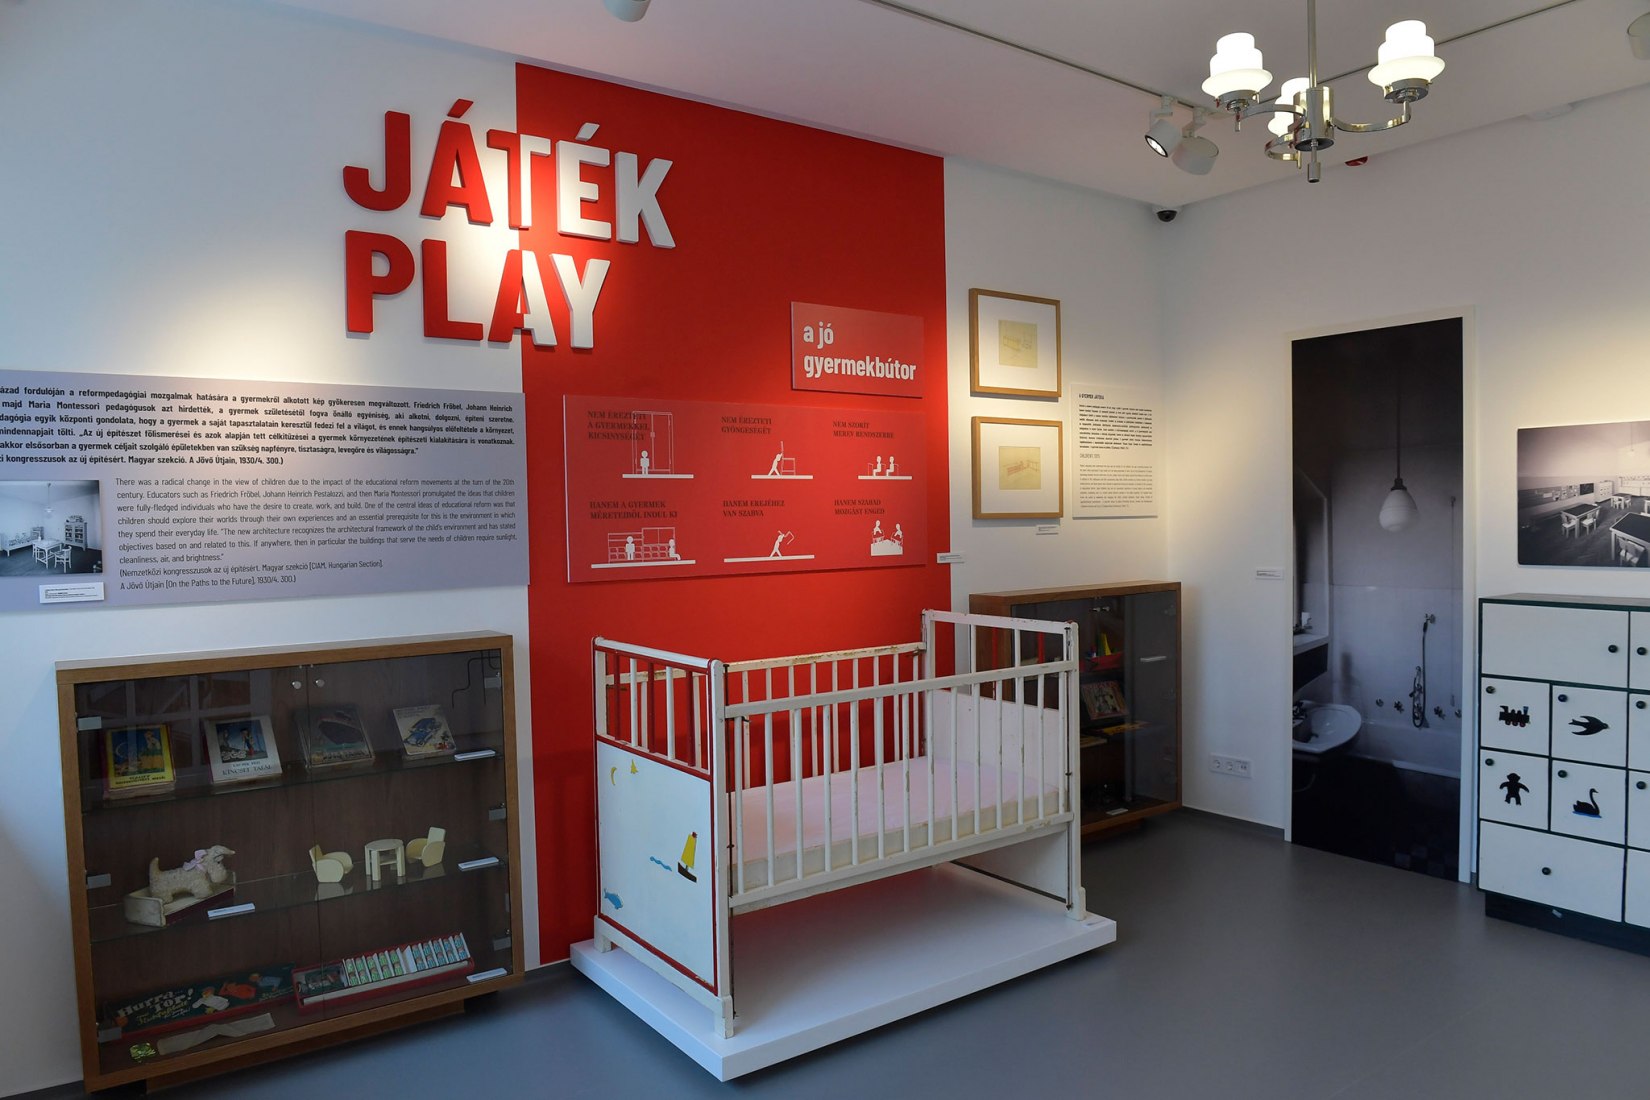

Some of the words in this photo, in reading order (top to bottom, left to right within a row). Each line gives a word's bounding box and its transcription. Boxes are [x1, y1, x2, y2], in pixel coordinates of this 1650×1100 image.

[343, 98, 676, 248] JÁTÉK
[345, 230, 610, 349] PLAY
[804, 326, 814, 342] a
[818, 322, 834, 349] jó
[804, 355, 916, 380] gyermekbútor
[24, 387, 65, 397] fordulóján
[79, 388, 146, 400] reformpedagógiai
[150, 391, 192, 401] mozgalmak
[240, 394, 280, 405] gyermekről
[283, 395, 309, 404] alkotott
[312, 396, 325, 406] kép
[328, 397, 365, 408] gyökeresen
[414, 400, 440, 408] Friedrich
[2, 400, 22, 409] majd
[106, 402, 156, 413] pedagógusok
[228, 406, 259, 416] gyermek
[310, 409, 328, 418] fogva
[357, 410, 390, 420] egyéniség,
[35, 415, 56, 423] egyik
[60, 415, 93, 424] központi
[96, 415, 136, 425] gondolata,
[138, 417, 157, 426] hogy
[167, 417, 199, 426] gyermek
[209, 418, 226, 427] saját
[229, 418, 278, 429] tapasztalatain
[281, 419, 312, 428] keresztül
[314, 420, 334, 429] fedezi
[336, 421, 345, 429] fel
[354, 421, 376, 431] világot,
[389, 422, 407, 430] ennek
[96, 429, 103, 438] új
[107, 429, 141, 439] építészet
[225, 432, 250, 440] alapján
[318, 433, 346, 442] gyermek
[350, 434, 395, 444] környezetének
[26, 440, 69, 449] elsősorban
[79, 442, 112, 451] gyermek
[114, 443, 137, 451] céljait
[140, 443, 169, 452] szolgáló
[171, 444, 215, 453] épületekben
[231, 444, 260, 453] szükség
[261, 445, 296, 454] napfényre,
[298, 446, 336, 454] tisztaságra,
[338, 446, 365, 454] levegőre
[6, 454, 66, 464] kongresszusok
[80, 455, 86, 464] új
[89, 456, 126, 464] építésért.
[128, 456, 154, 465] Magyar
[216, 456, 237, 465] Útjain,
[117, 491, 144, 500] century.
